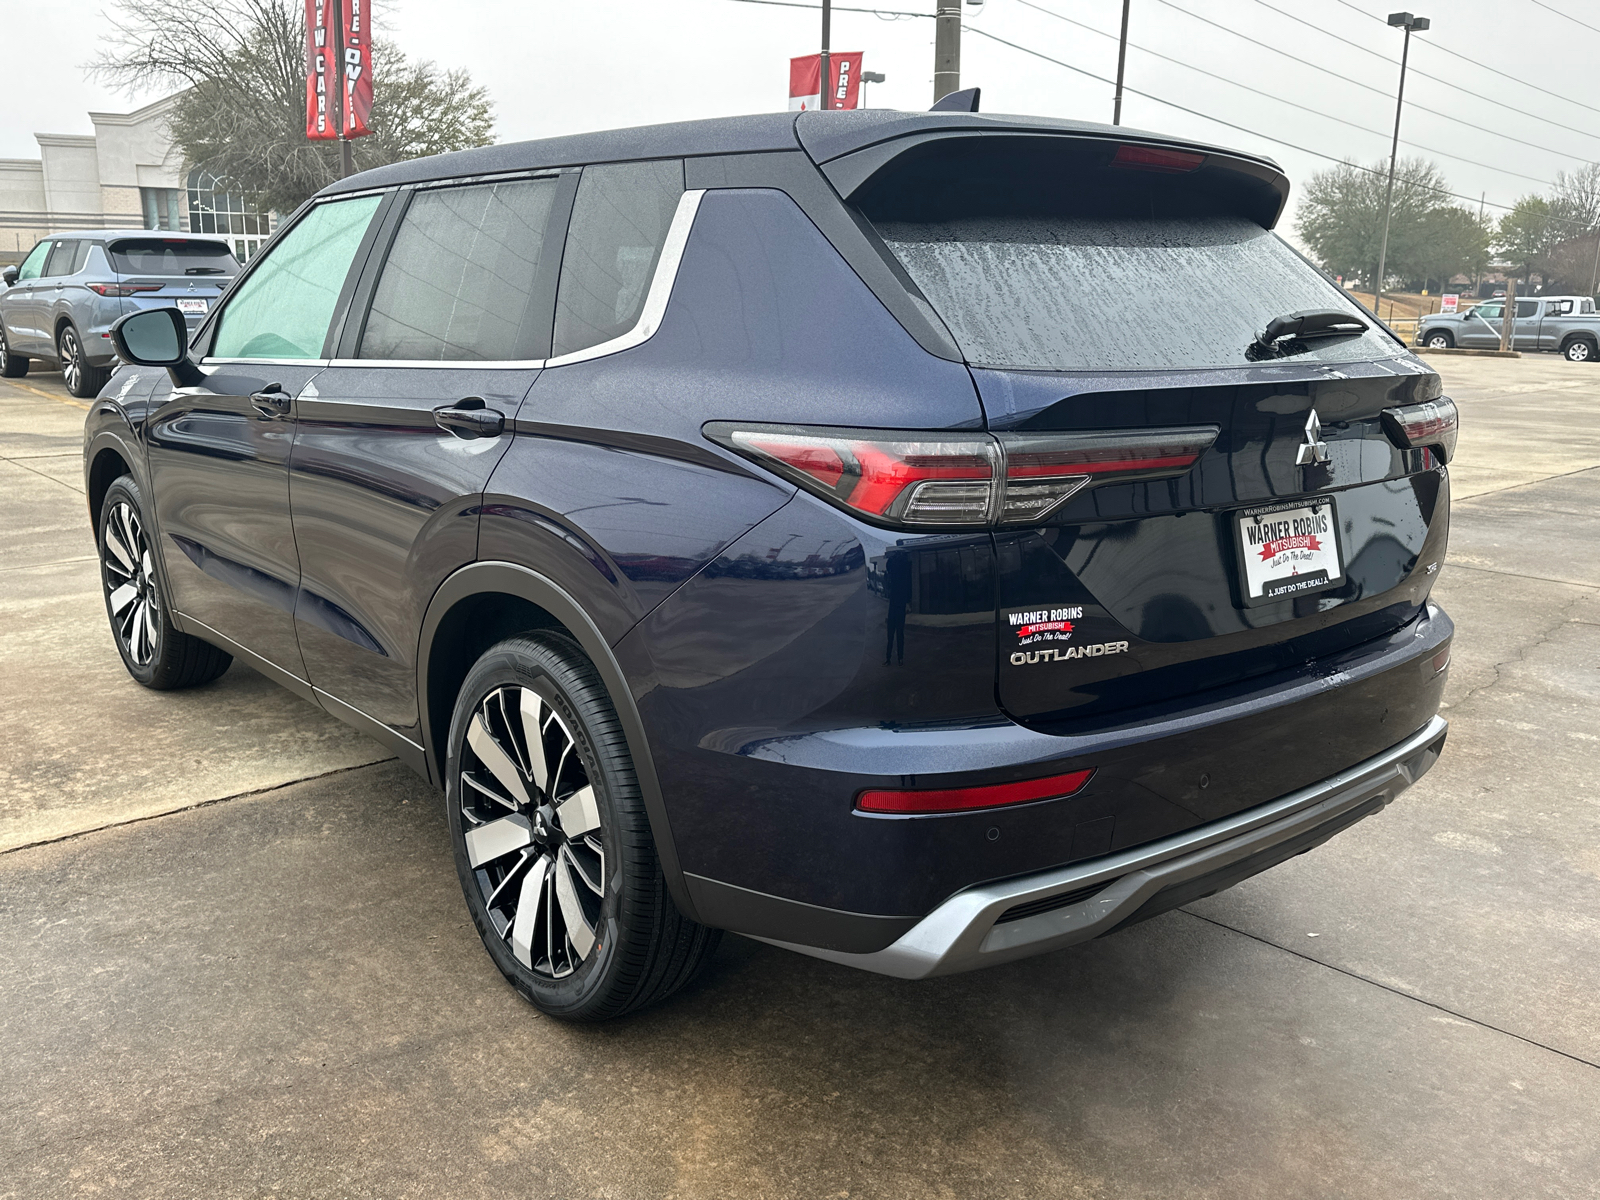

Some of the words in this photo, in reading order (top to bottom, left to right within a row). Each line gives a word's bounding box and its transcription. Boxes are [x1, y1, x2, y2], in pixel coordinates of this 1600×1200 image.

[315, 54, 326, 133] CARS
[1247, 520, 1290, 546] WARNER
[1293, 514, 1328, 537] ROBINS
[1270, 537, 1311, 553] MITSUBISHI
[1271, 557, 1282, 568] Just
[1282, 553, 1290, 563] Do
[1290, 551, 1299, 561] The
[1274, 586, 1287, 596] JUST
[1288, 584, 1297, 593] DO
[1297, 581, 1307, 590] THE
[1008, 610, 1049, 626] WARNER
[1050, 606, 1083, 622] ROBINS
[1028, 622, 1065, 633] MITSUBISHI
[1018, 637, 1033, 646] Just
[1033, 633, 1042, 642] Do
[1042, 631, 1053, 641] The
[1009, 641, 1129, 666] OUTLANDER
[553, 693, 603, 787] ROADIAN
